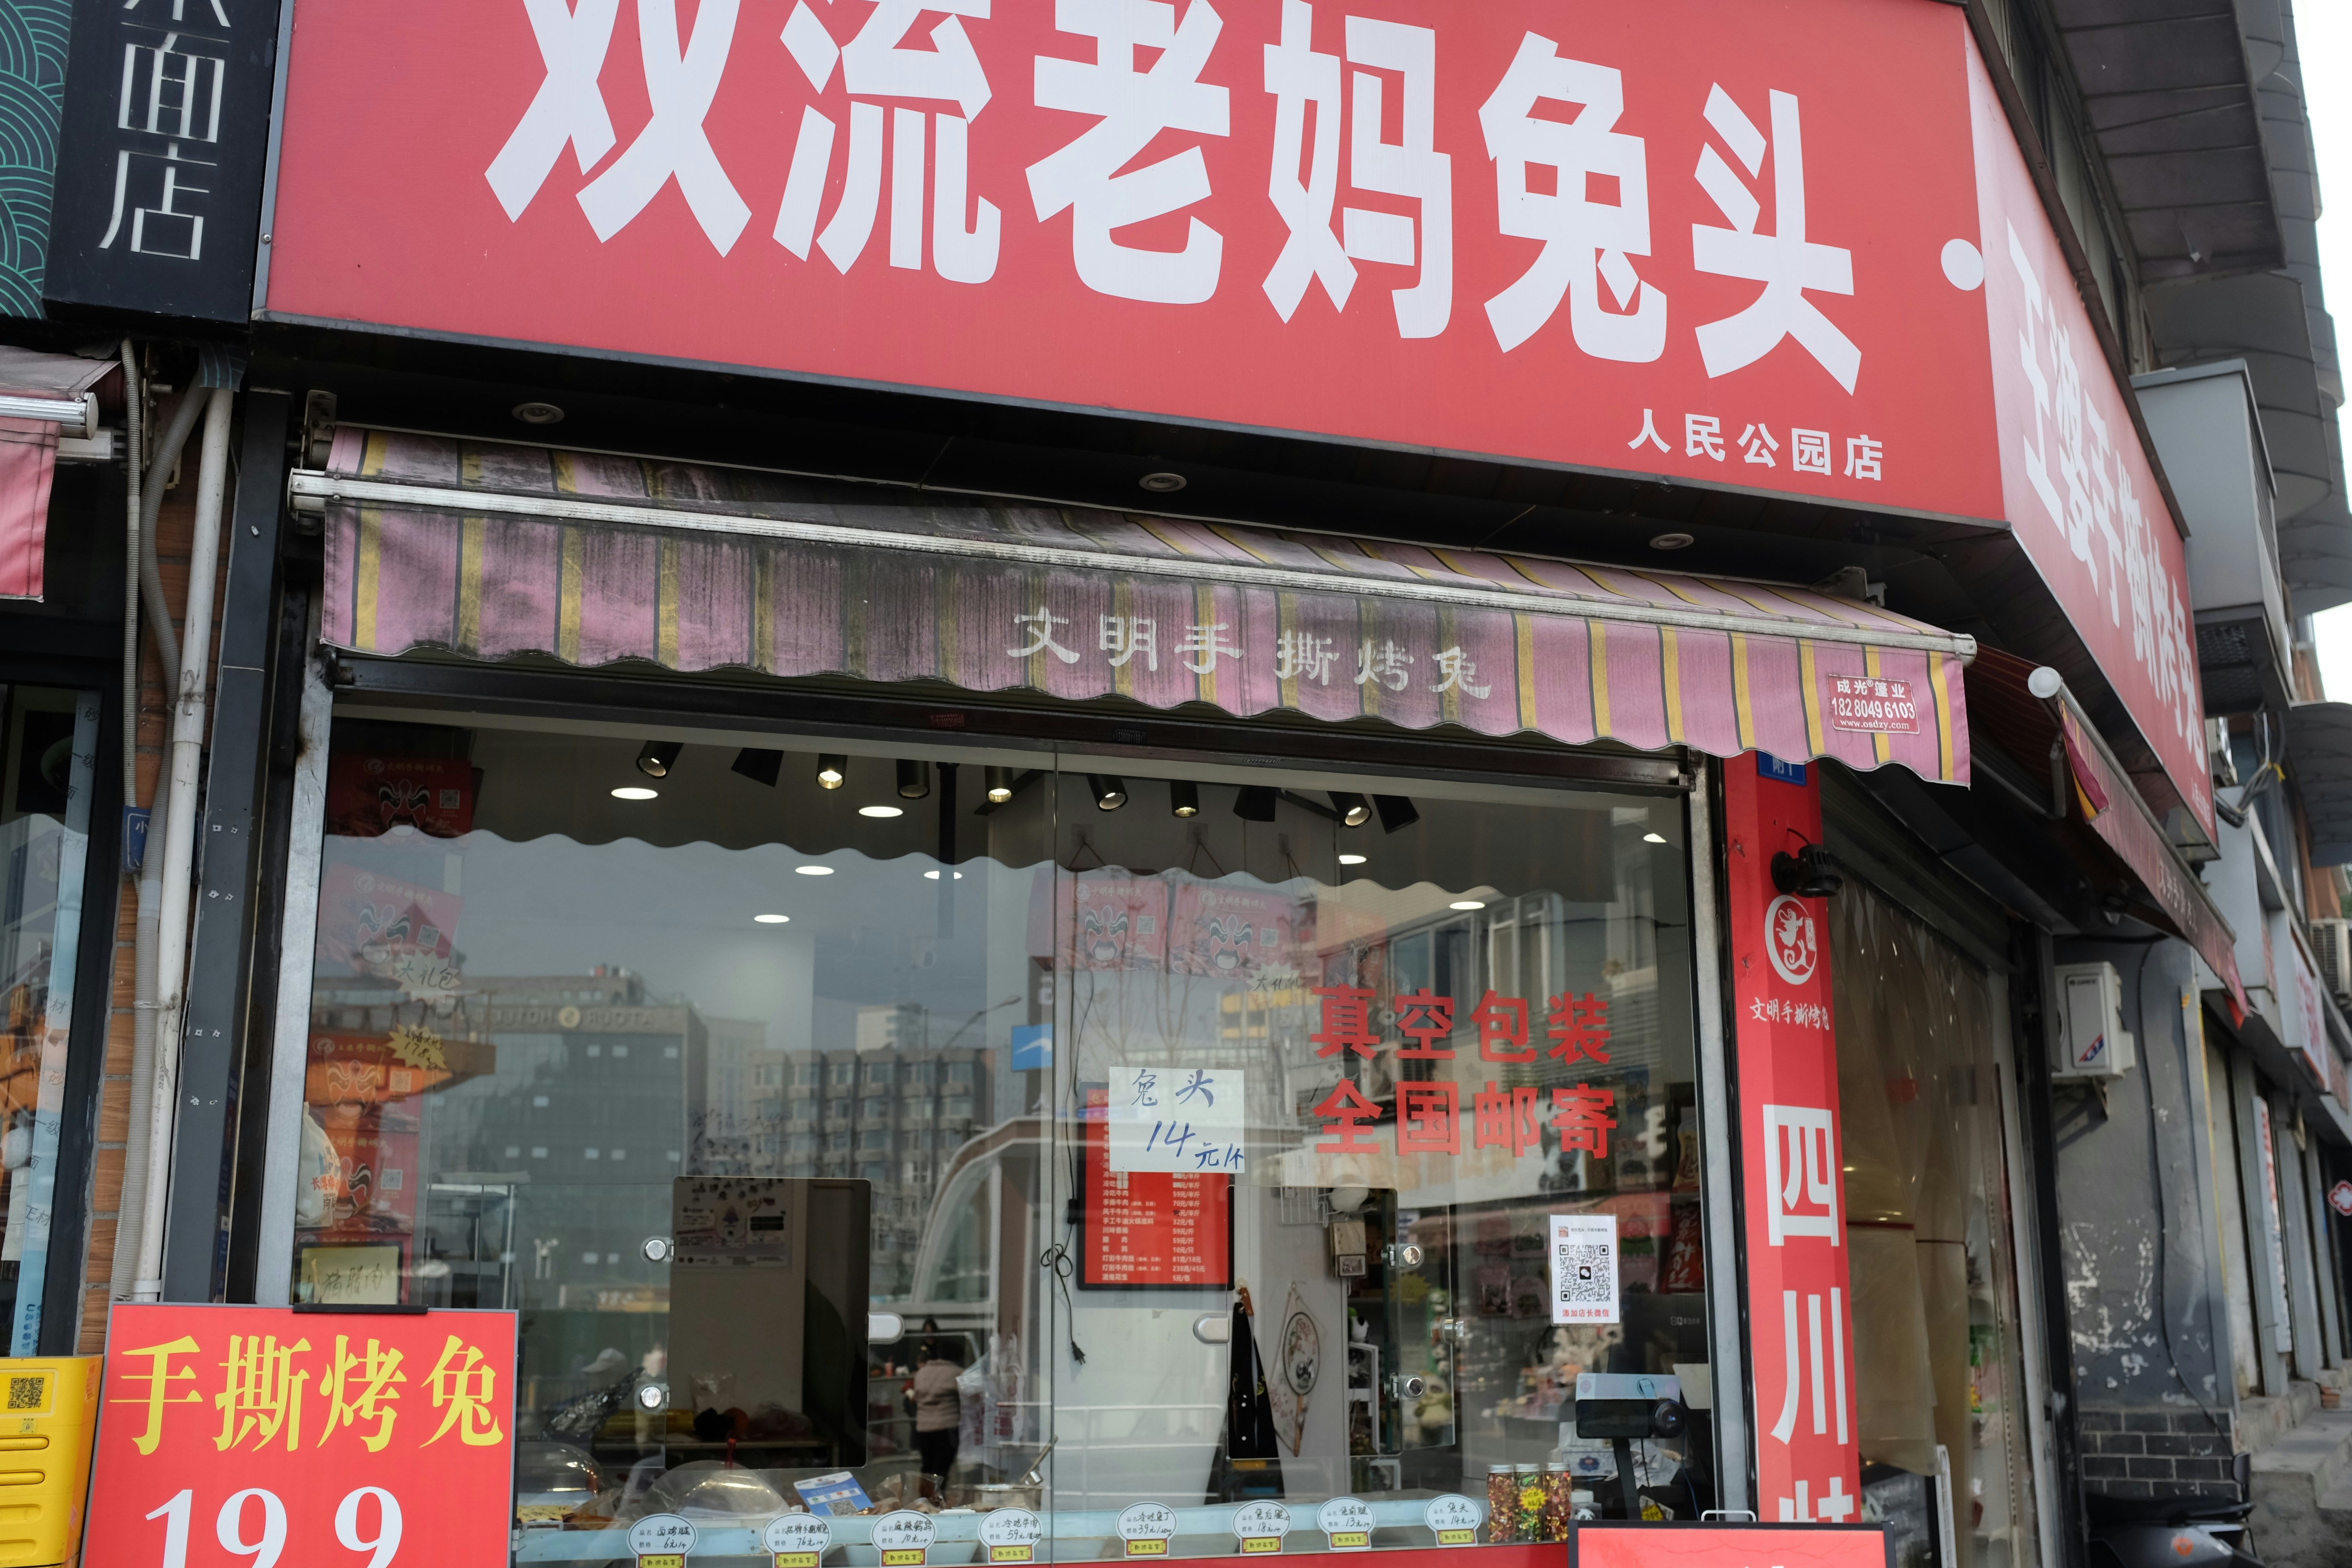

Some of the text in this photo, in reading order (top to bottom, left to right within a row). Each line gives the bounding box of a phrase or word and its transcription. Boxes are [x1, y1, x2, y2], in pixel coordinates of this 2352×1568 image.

[98, 0, 231, 260] 面店
[484, 0, 1862, 396] 双流老妈兔头
[1628, 408, 1883, 481] 人民公园店
[2007, 215, 2205, 776] 王婆手撕烤兔
[1007, 607, 1492, 700] 文明手撕烤兔
[1839, 720, 1910, 730] www.osdzy.com
[398, 962, 454, 990] 大礼包
[1310, 983, 1612, 1066] 真空包装
[1131, 1069, 1214, 1108] 兔头
[1312, 1078, 1617, 1159] 全国邮寄
[1562, 1309, 1609, 1317] 添加店长微信
[109, 1334, 503, 1456] 手撕烤兔
